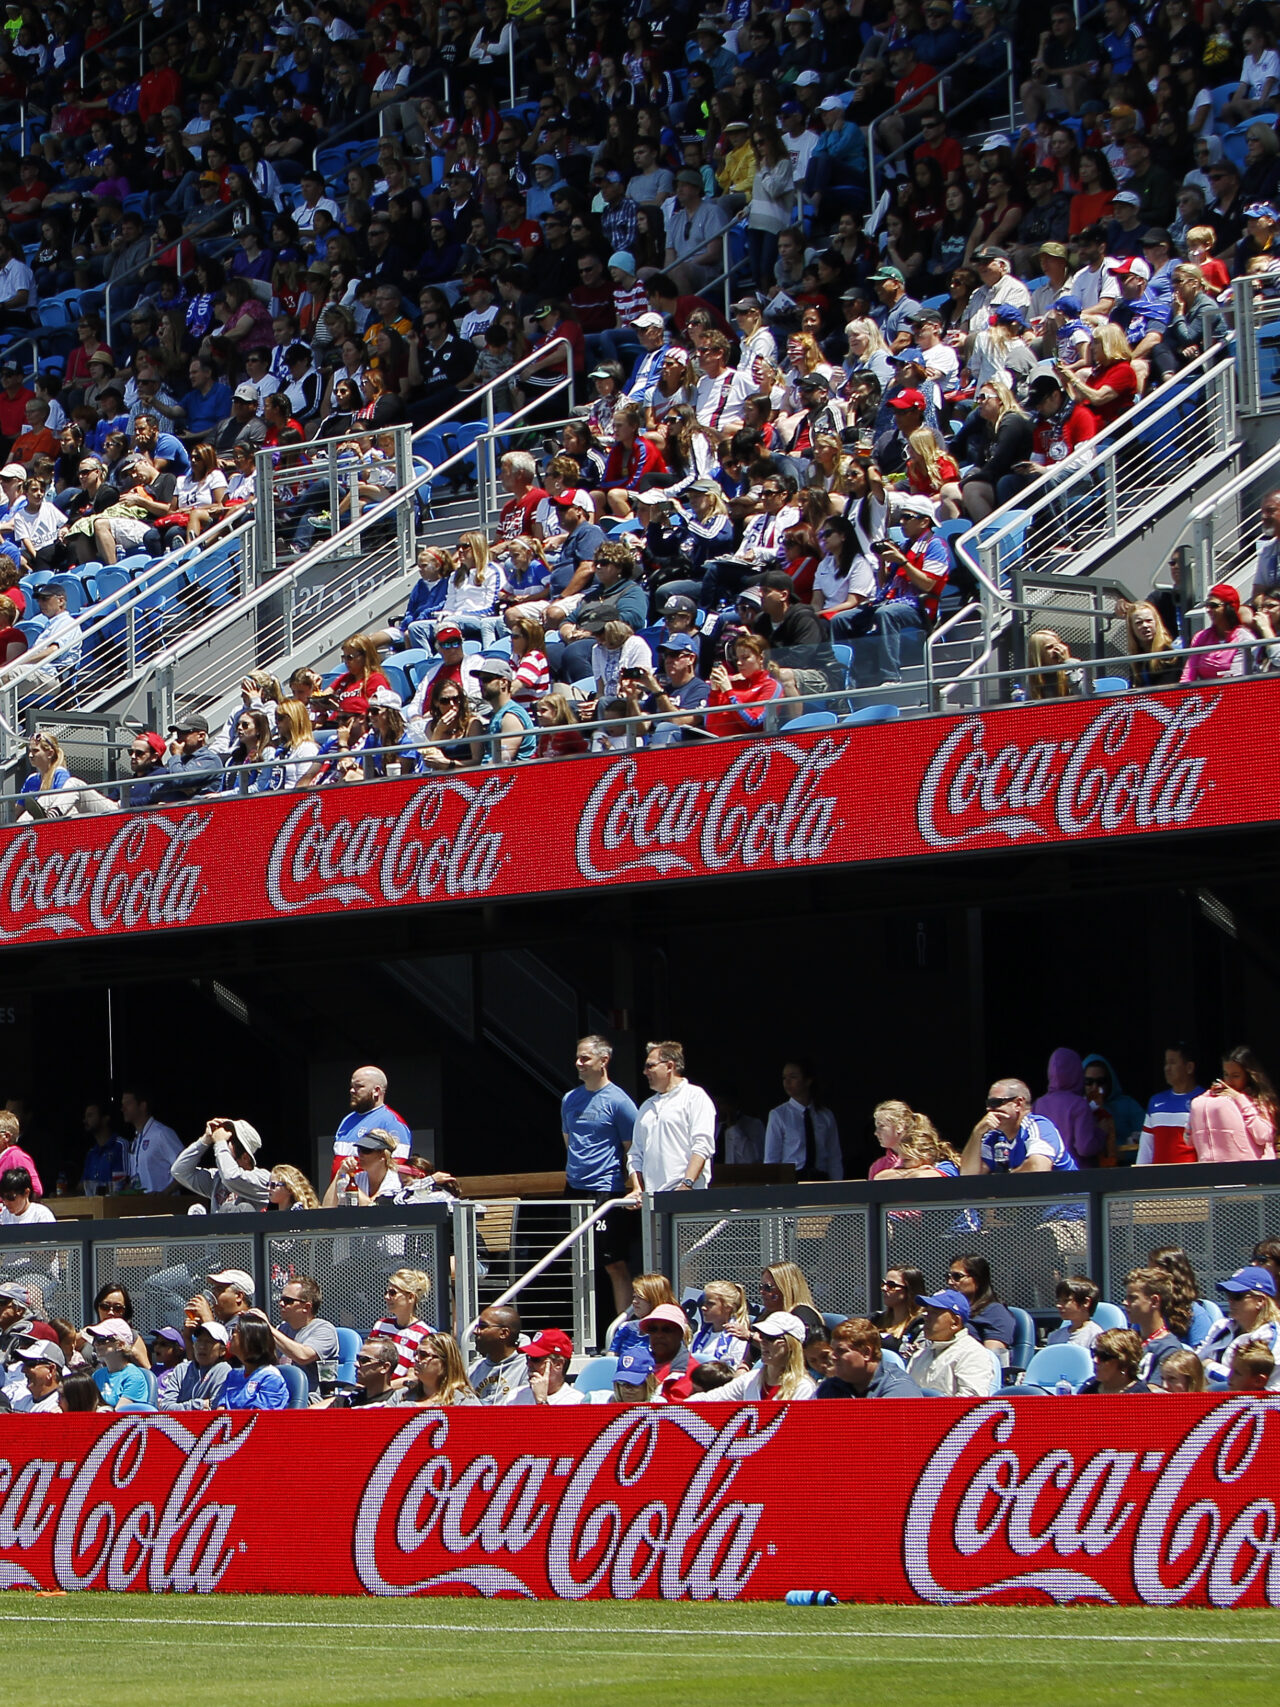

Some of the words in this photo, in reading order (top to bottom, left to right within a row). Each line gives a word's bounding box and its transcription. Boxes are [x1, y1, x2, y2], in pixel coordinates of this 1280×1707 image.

[267, 776, 515, 914] Coca-Cola
[576, 737, 853, 884] Coca-Cola
[919, 692, 1221, 850] Coca-Cola
[595, 1220, 607, 1232] 26
[354, 1404, 790, 1601] Coca-Cola
[903, 1396, 1280, 1608] Coca-Co
